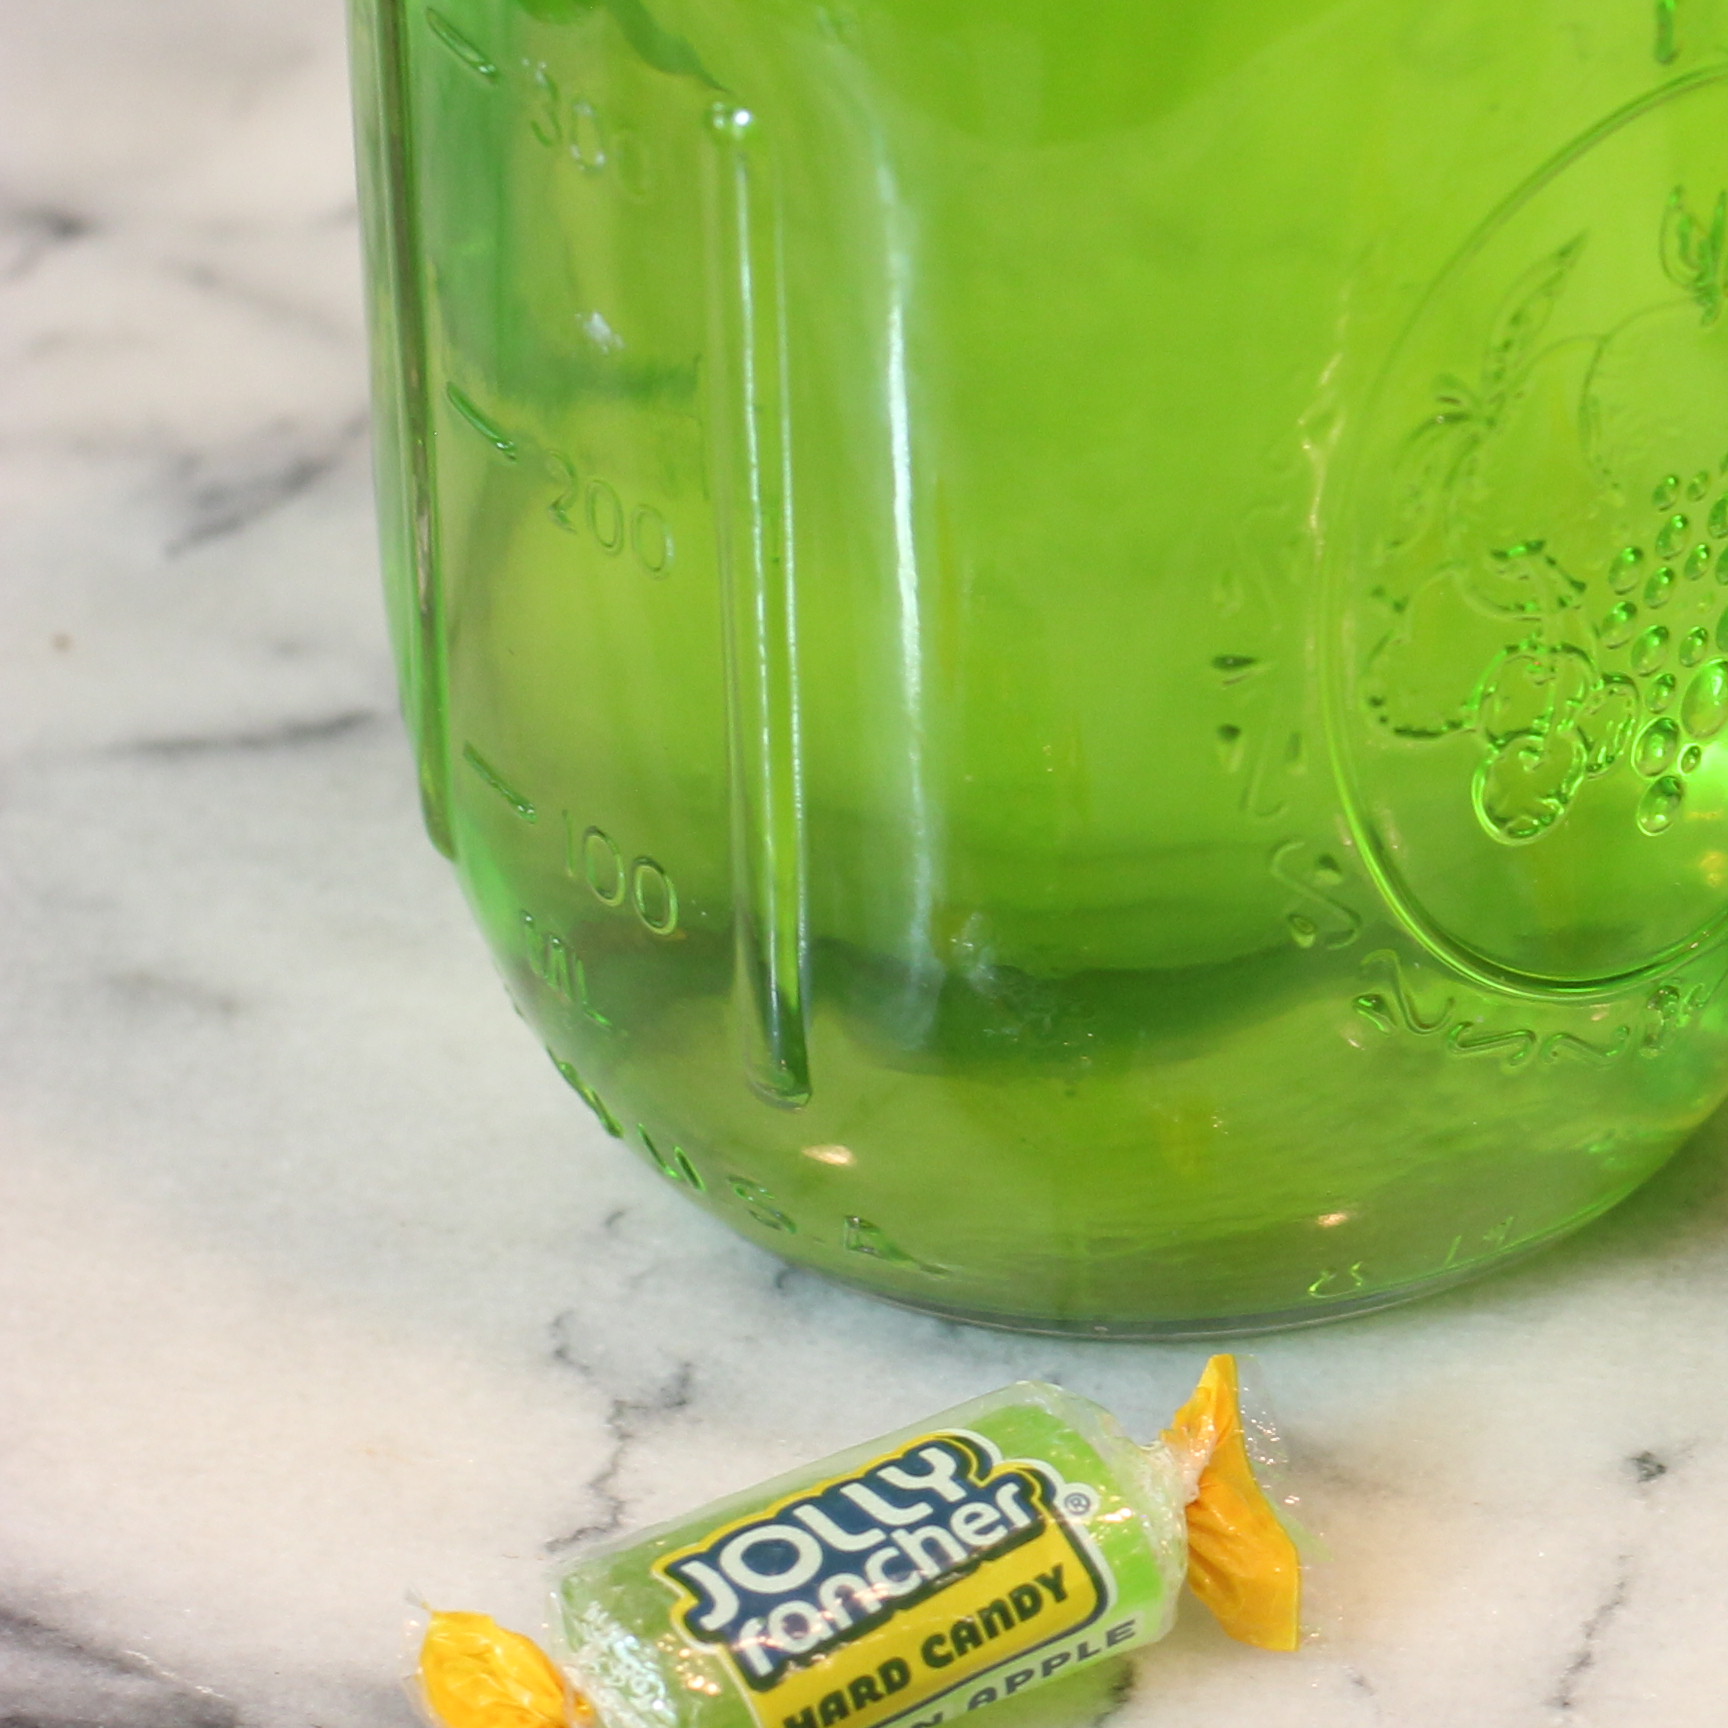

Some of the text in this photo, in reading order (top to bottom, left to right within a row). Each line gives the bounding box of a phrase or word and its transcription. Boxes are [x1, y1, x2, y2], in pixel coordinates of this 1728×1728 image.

[545, 447, 677, 581] 200
[561, 808, 679, 937] 100
[680, 1446, 968, 1633] JOLLY
[738, 1481, 1032, 1676] rancher
[920, 1563, 1070, 1670] CANDY
[967, 1618, 1138, 1712] APPLE
